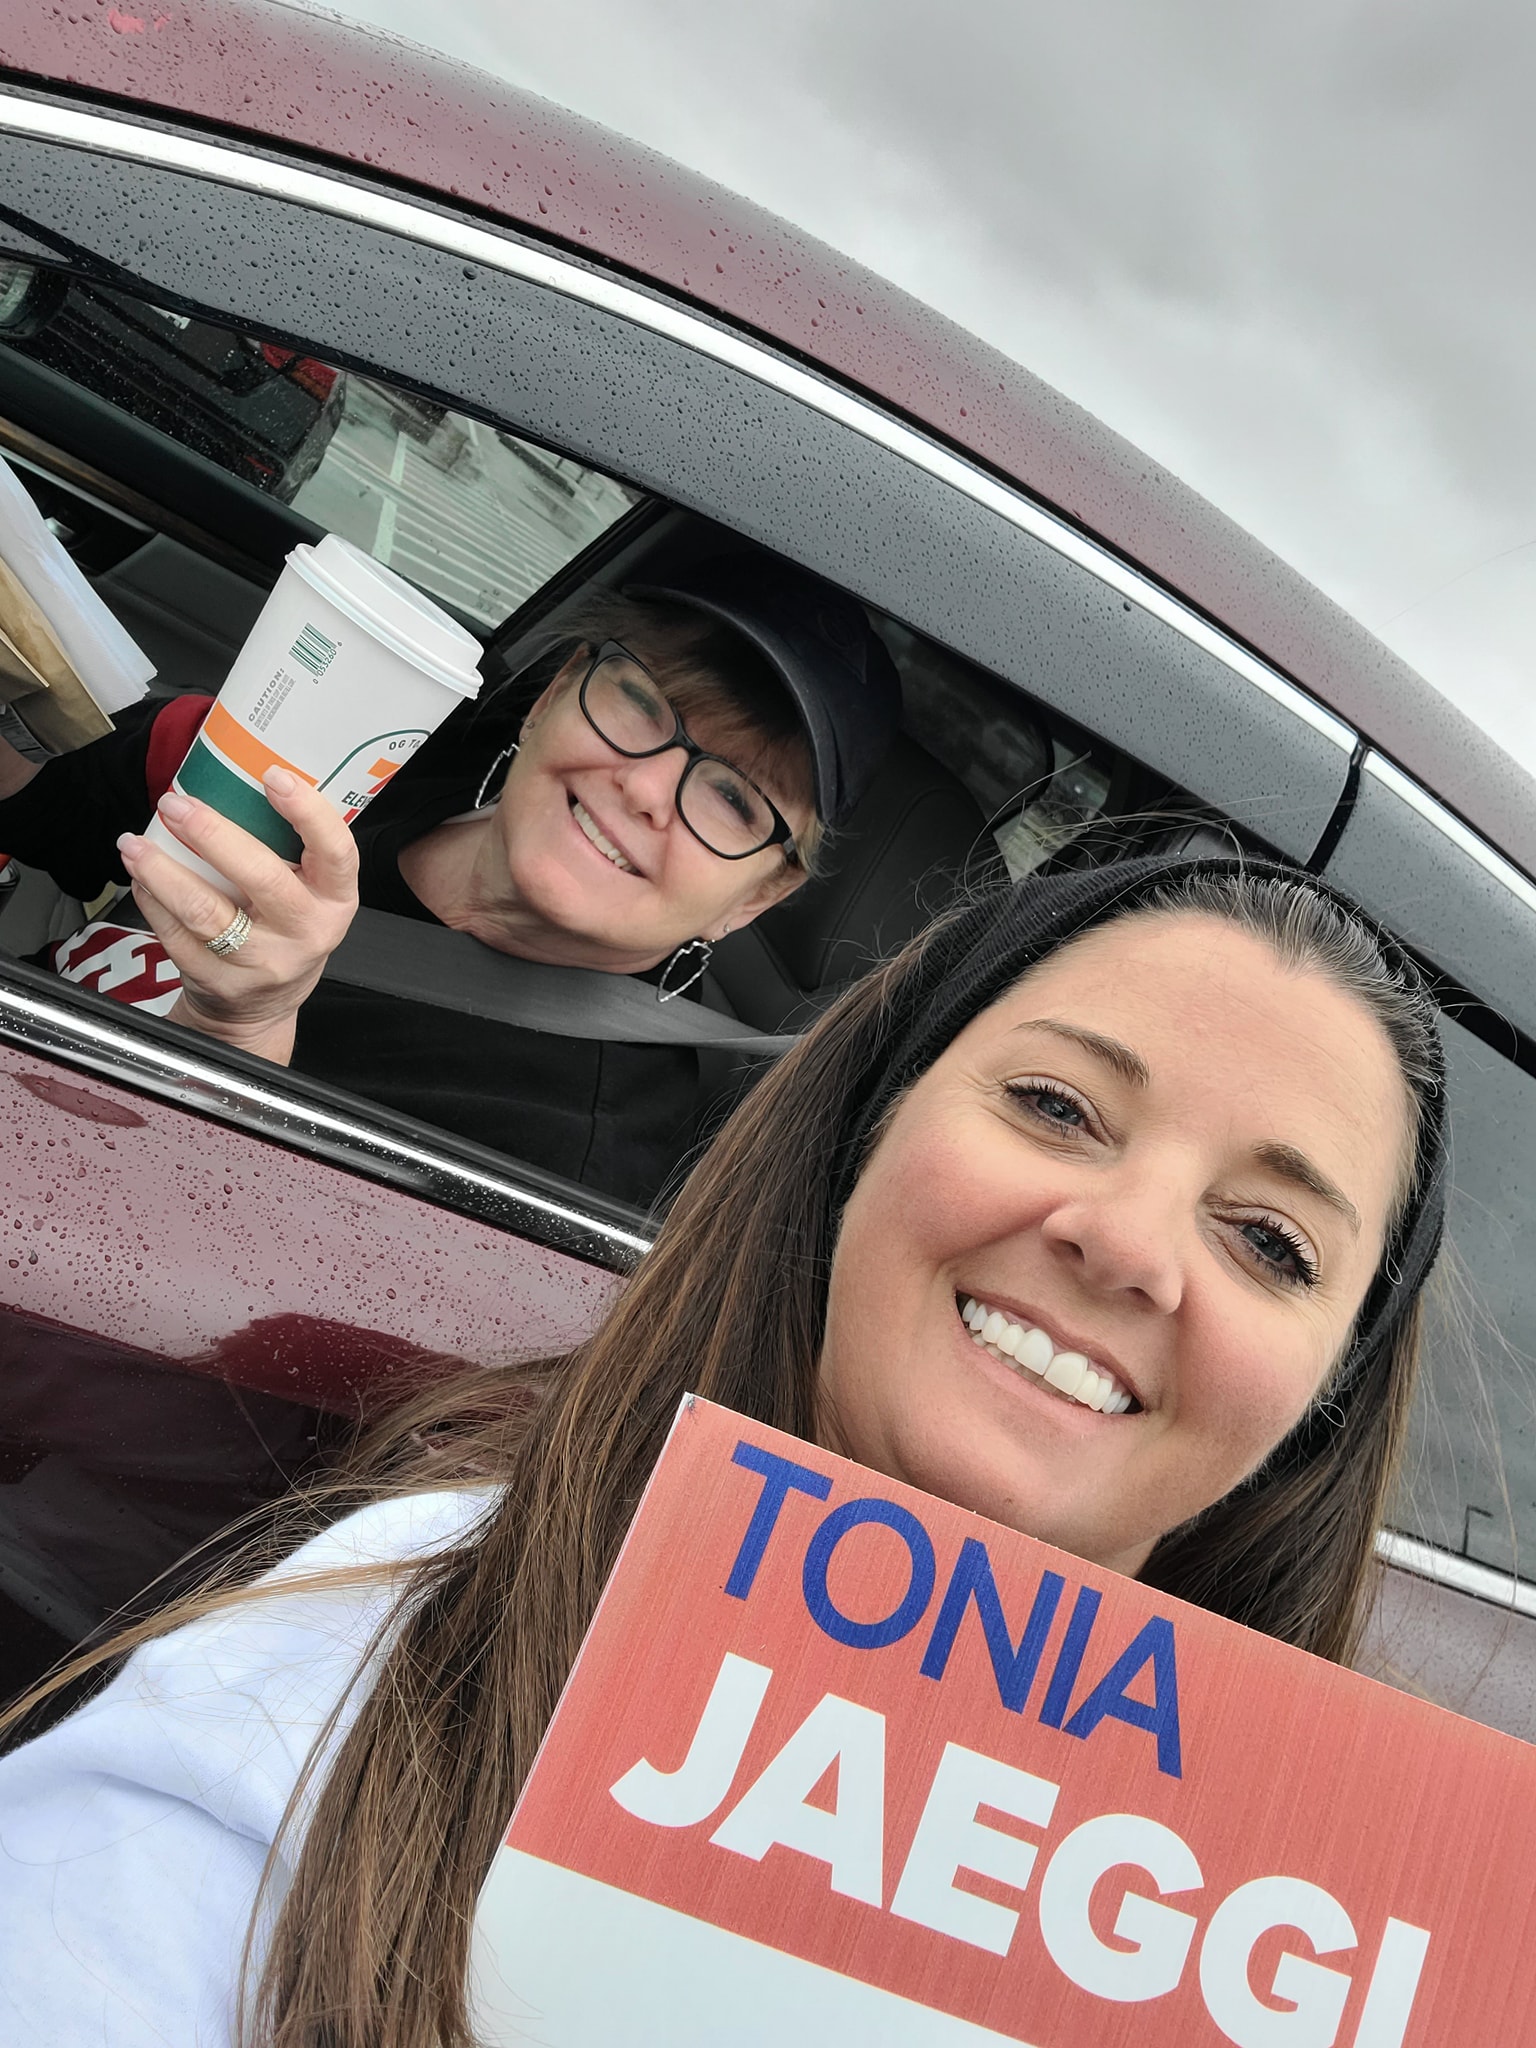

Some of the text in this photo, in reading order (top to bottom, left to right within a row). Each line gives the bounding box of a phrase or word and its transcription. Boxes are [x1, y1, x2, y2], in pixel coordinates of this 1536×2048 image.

[248, 667, 285, 722] CAUTION:
[724, 1441, 1182, 1779] TONIA
[609, 1652, 1430, 2048] JAEGGI
